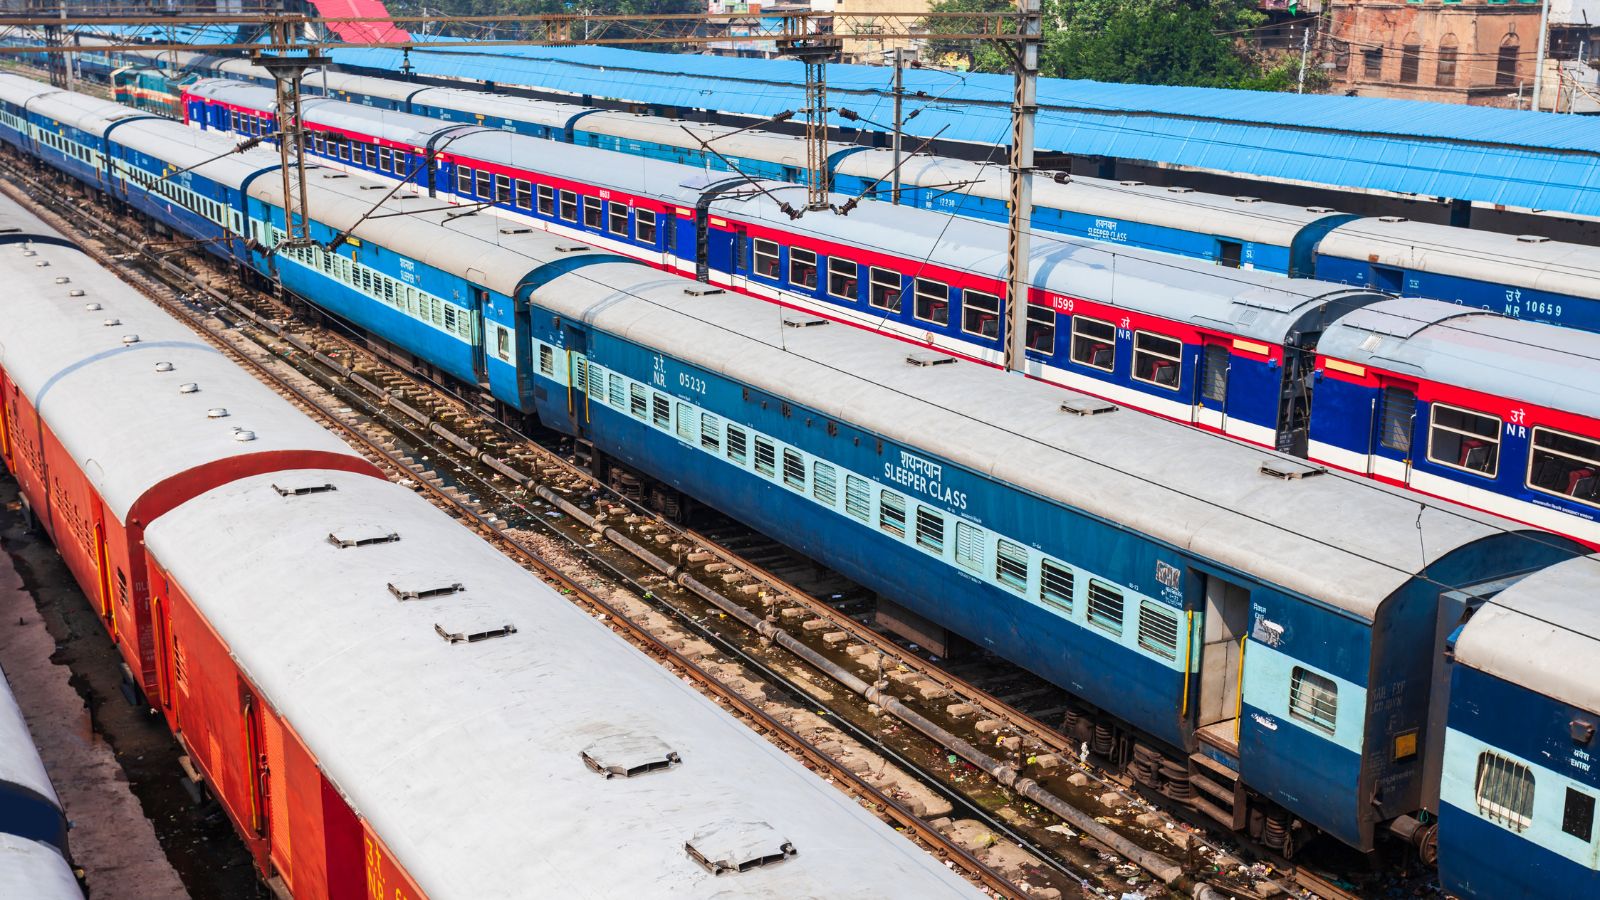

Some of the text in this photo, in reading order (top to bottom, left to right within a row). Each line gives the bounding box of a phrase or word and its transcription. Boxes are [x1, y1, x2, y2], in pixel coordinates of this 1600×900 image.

[1087, 227, 1127, 242] SLEEPER CLASS
[1053, 296, 1074, 312] 11599
[1505, 304, 1520, 317] NR
[1526, 300, 1562, 317] 10659
[679, 372, 706, 395] 05232
[1506, 423, 1526, 439] NR
[900, 450, 942, 482] शयनयान
[884, 462, 967, 510] SLEEPER CLASS
[1570, 758, 1591, 772] ENTRY
